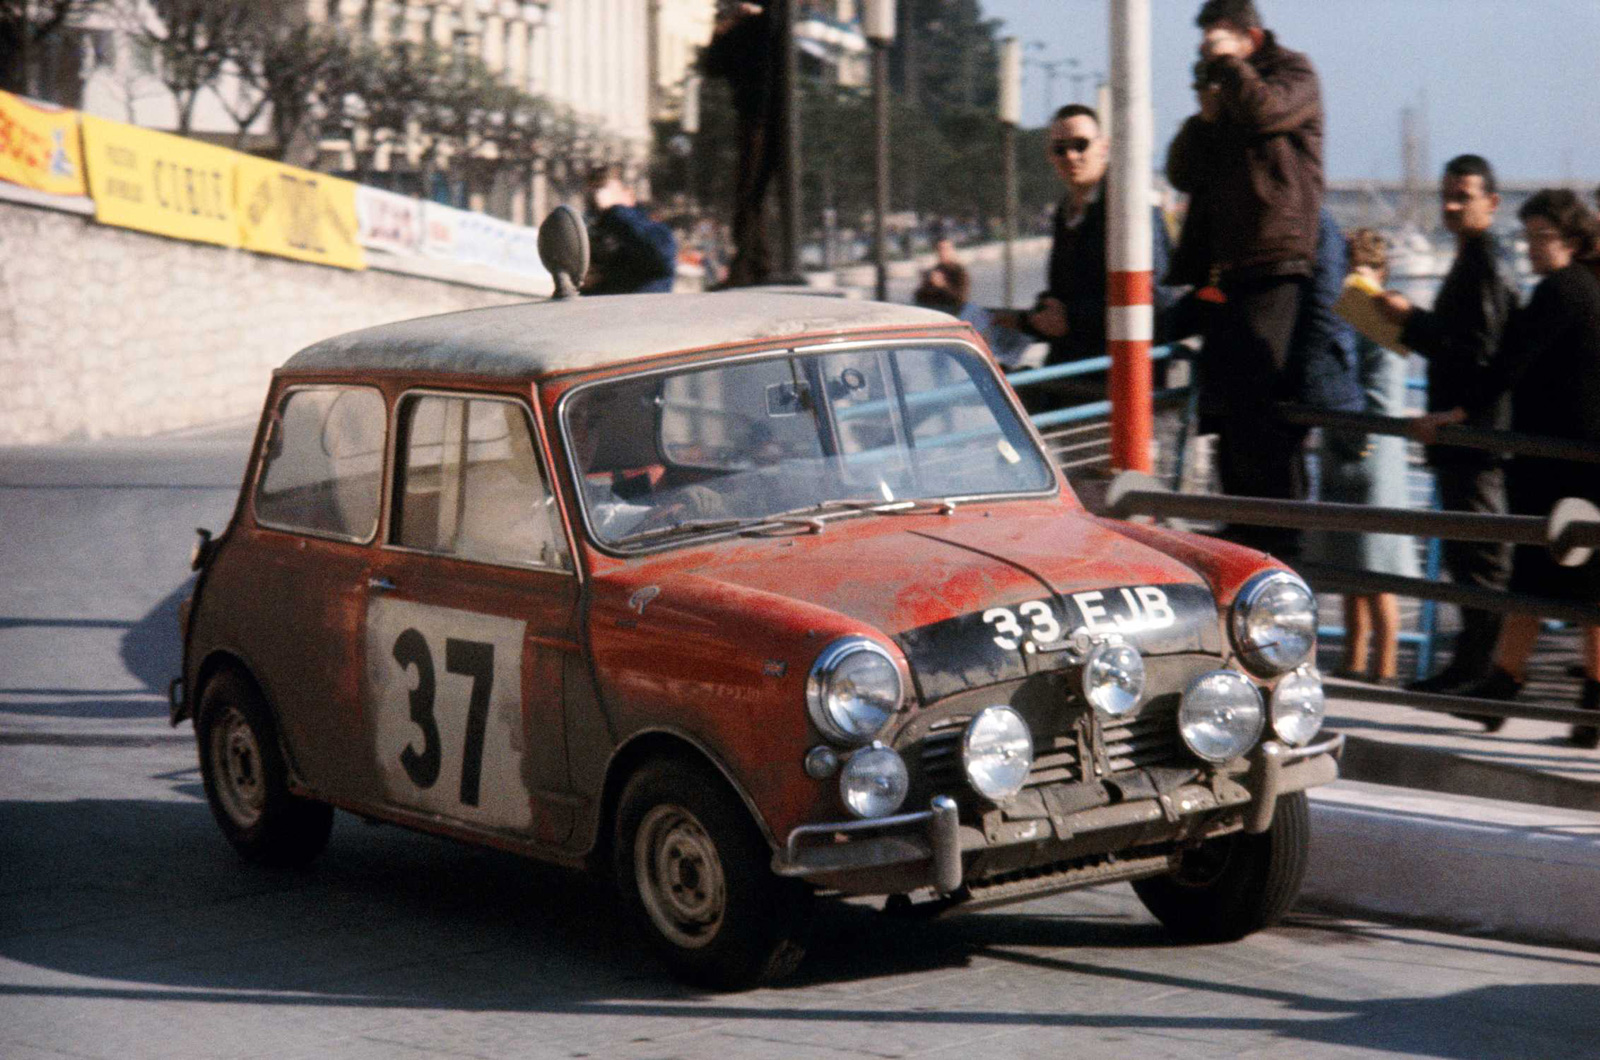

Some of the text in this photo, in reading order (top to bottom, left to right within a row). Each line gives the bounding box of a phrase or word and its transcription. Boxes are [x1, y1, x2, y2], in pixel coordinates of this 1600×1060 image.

[982, 586, 1176, 650] 33 EJB
[392, 627, 495, 807] 37
